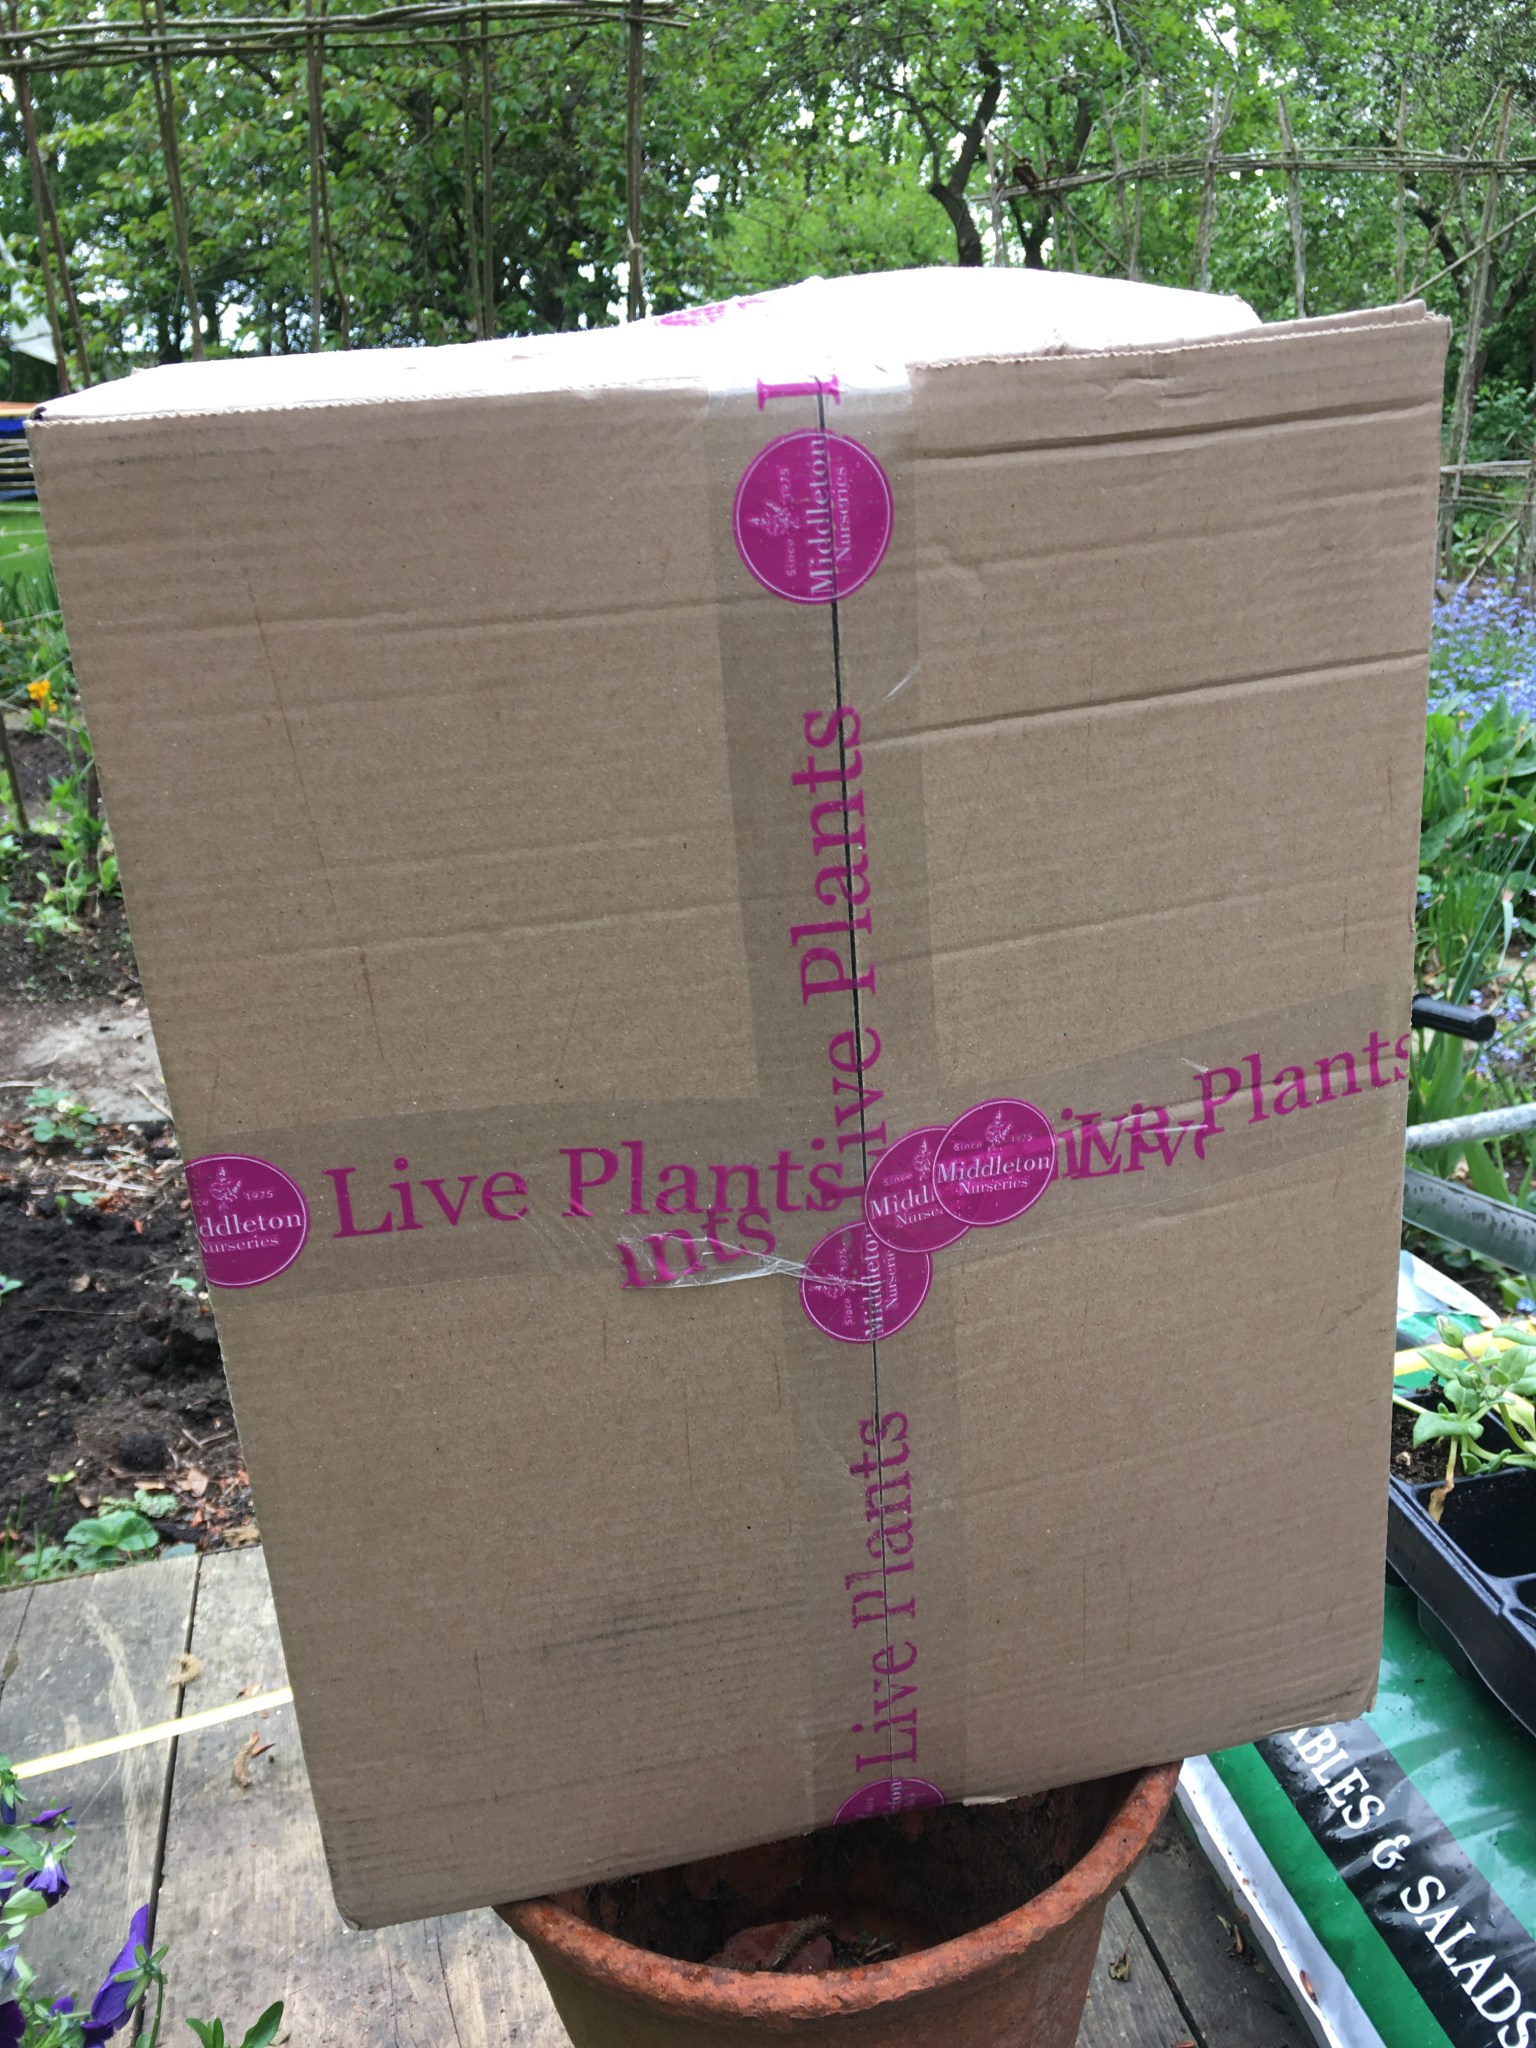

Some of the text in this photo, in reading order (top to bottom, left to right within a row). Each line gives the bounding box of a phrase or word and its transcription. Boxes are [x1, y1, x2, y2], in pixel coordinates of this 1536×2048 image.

[806, 439, 834, 594] Middleton
[833, 466, 851, 561] Nurseries
[790, 704, 877, 1005] Plants
[245, 1190, 274, 1201] 1975
[322, 1139, 843, 1239] Live Plants
[936, 1155, 1051, 1184] Middleton
[959, 1176, 1029, 1196] Nurseries
[199, 1213, 303, 1238] ddleton
[844, 1410, 916, 1630] Plants
[851, 1641, 918, 1773] Live
[1372, 1834, 1411, 1870] &
[1400, 1875, 1536, 2048] SALADS
